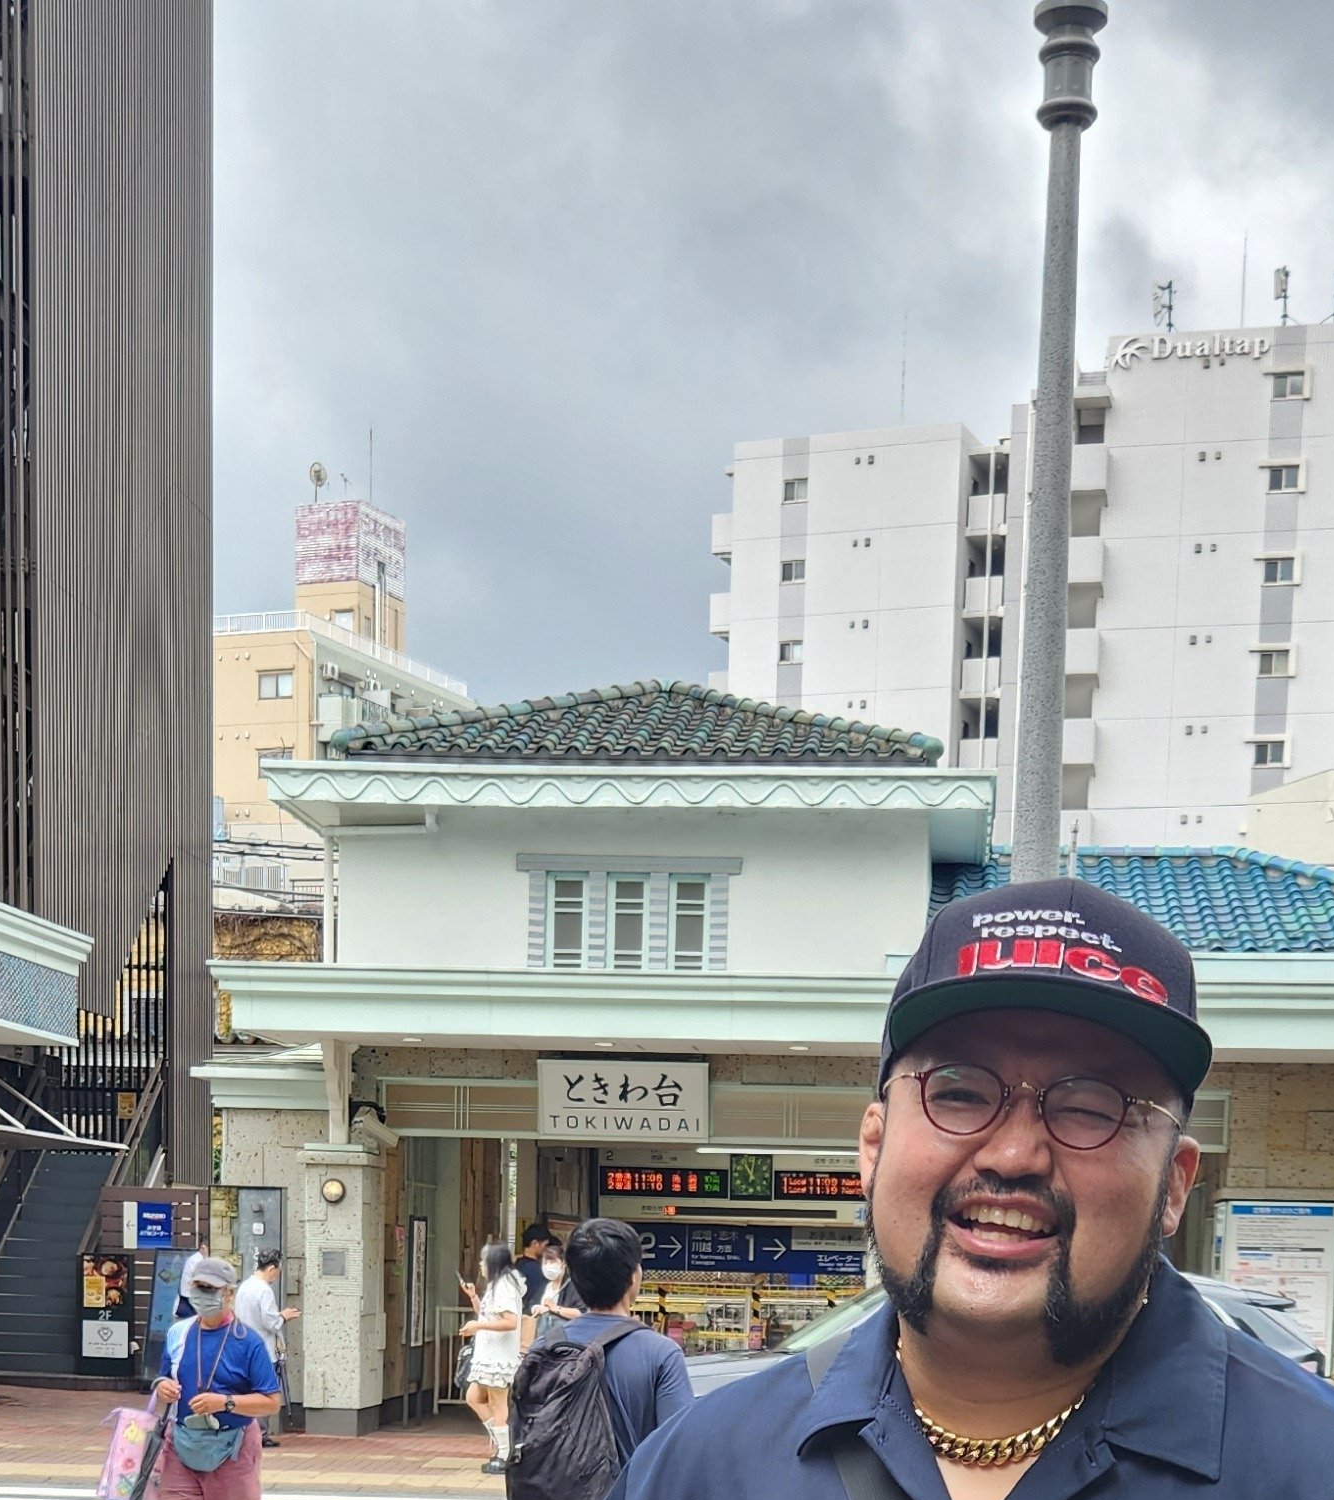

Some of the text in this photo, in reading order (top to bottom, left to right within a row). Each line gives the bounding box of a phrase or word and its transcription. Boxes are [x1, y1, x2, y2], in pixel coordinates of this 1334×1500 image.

[1152, 333, 1271, 360] Dualtap
[972, 908, 1086, 929] power.
[981, 923, 1123, 954] respect.
[563, 1072, 683, 1107] ときわ台
[549, 1114, 701, 1132] TOKIWADAI
[606, 1150, 614, 1161] 2
[640, 1232, 656, 1259] 2
[745, 1234, 755, 1262] 1
[816, 1254, 861, 1263] エレベーター
[98, 1310, 113, 1321] 2F
